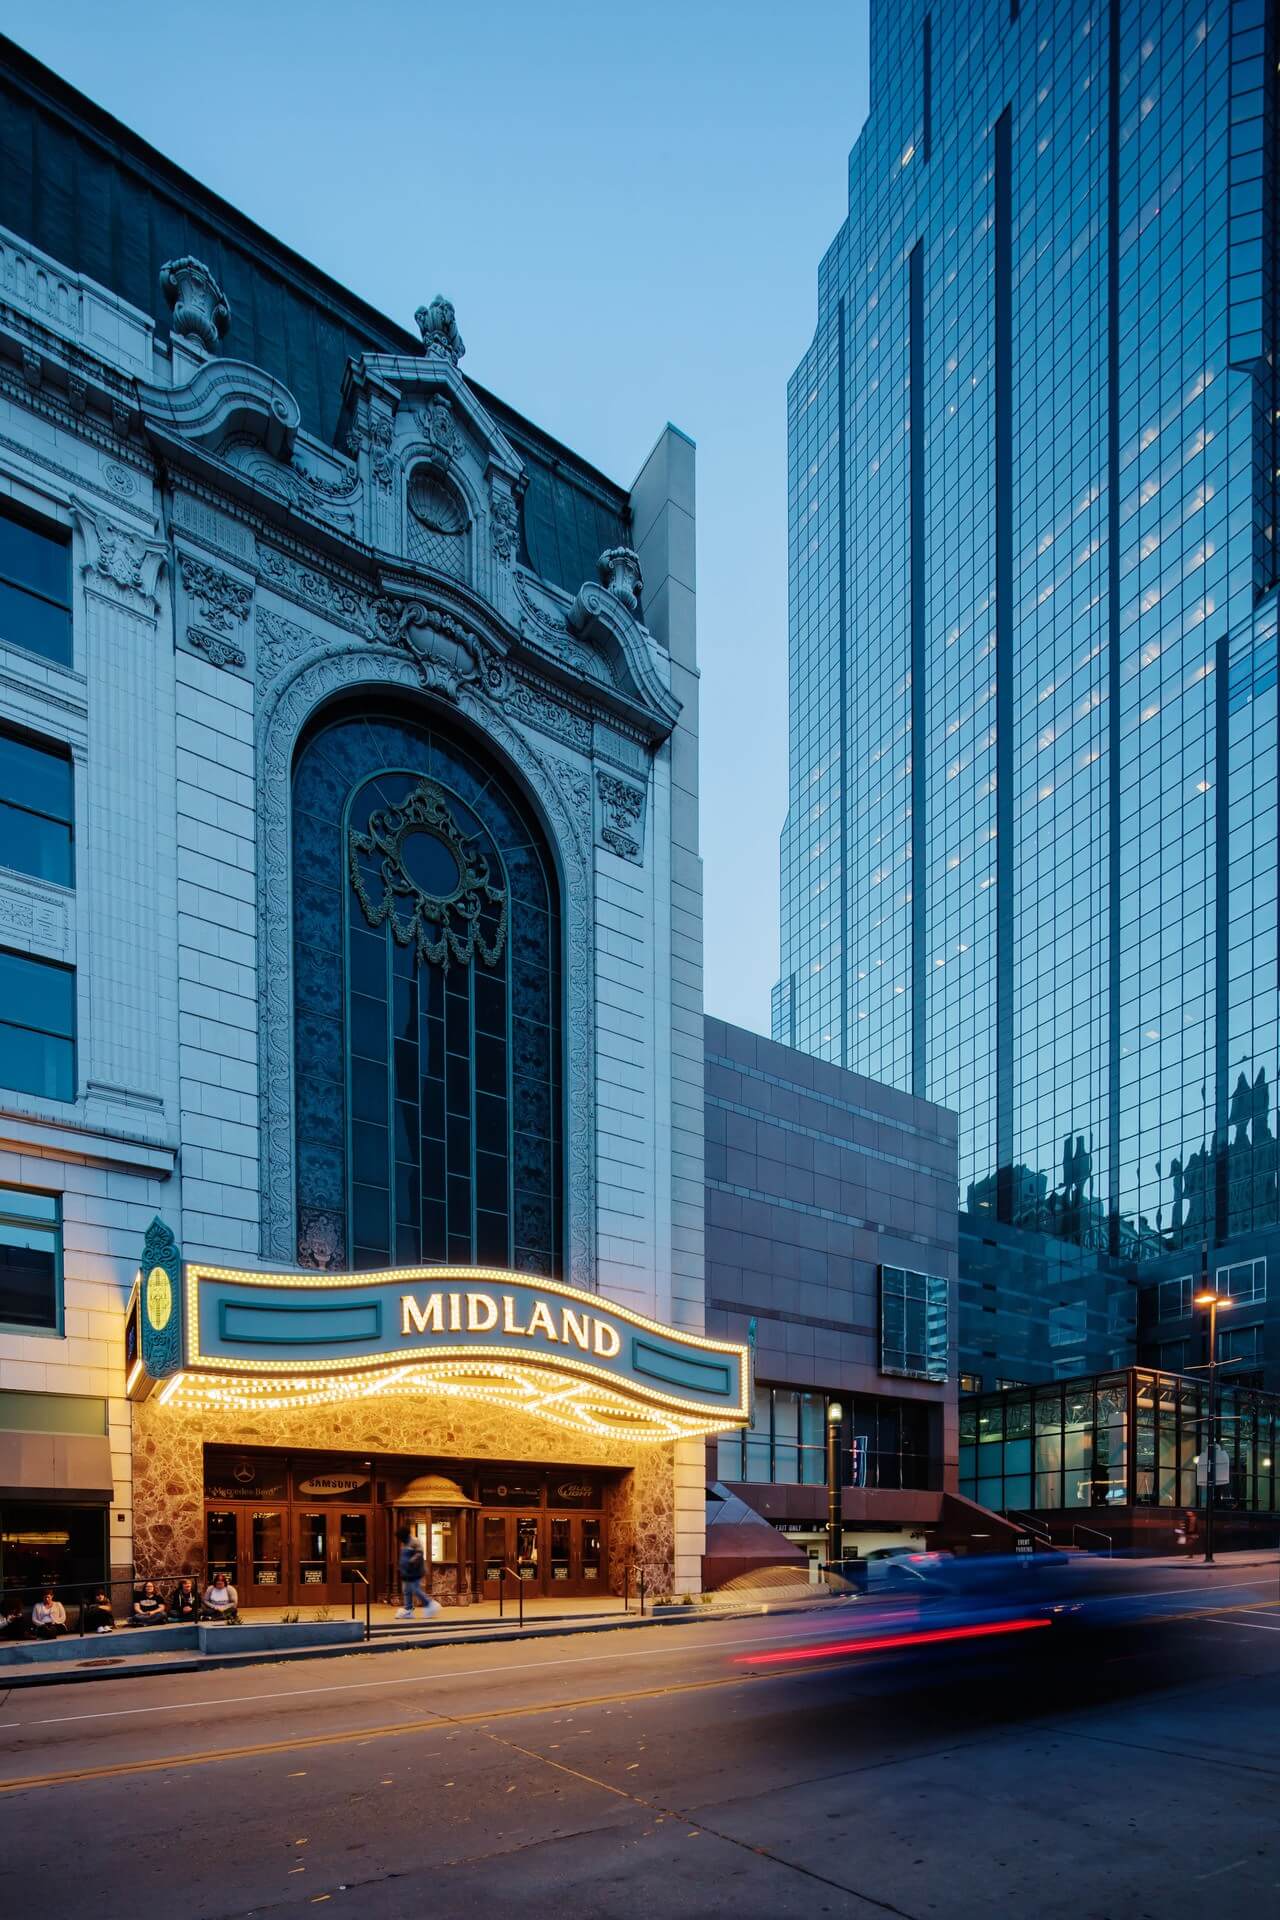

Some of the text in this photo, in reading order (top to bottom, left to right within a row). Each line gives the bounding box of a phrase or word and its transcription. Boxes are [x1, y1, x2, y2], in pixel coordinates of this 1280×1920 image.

[401, 1293, 621, 1358] MIDLAND
[308, 1479, 359, 1489] SAMSUNG
[788, 1524, 802, 1532] ONLY
